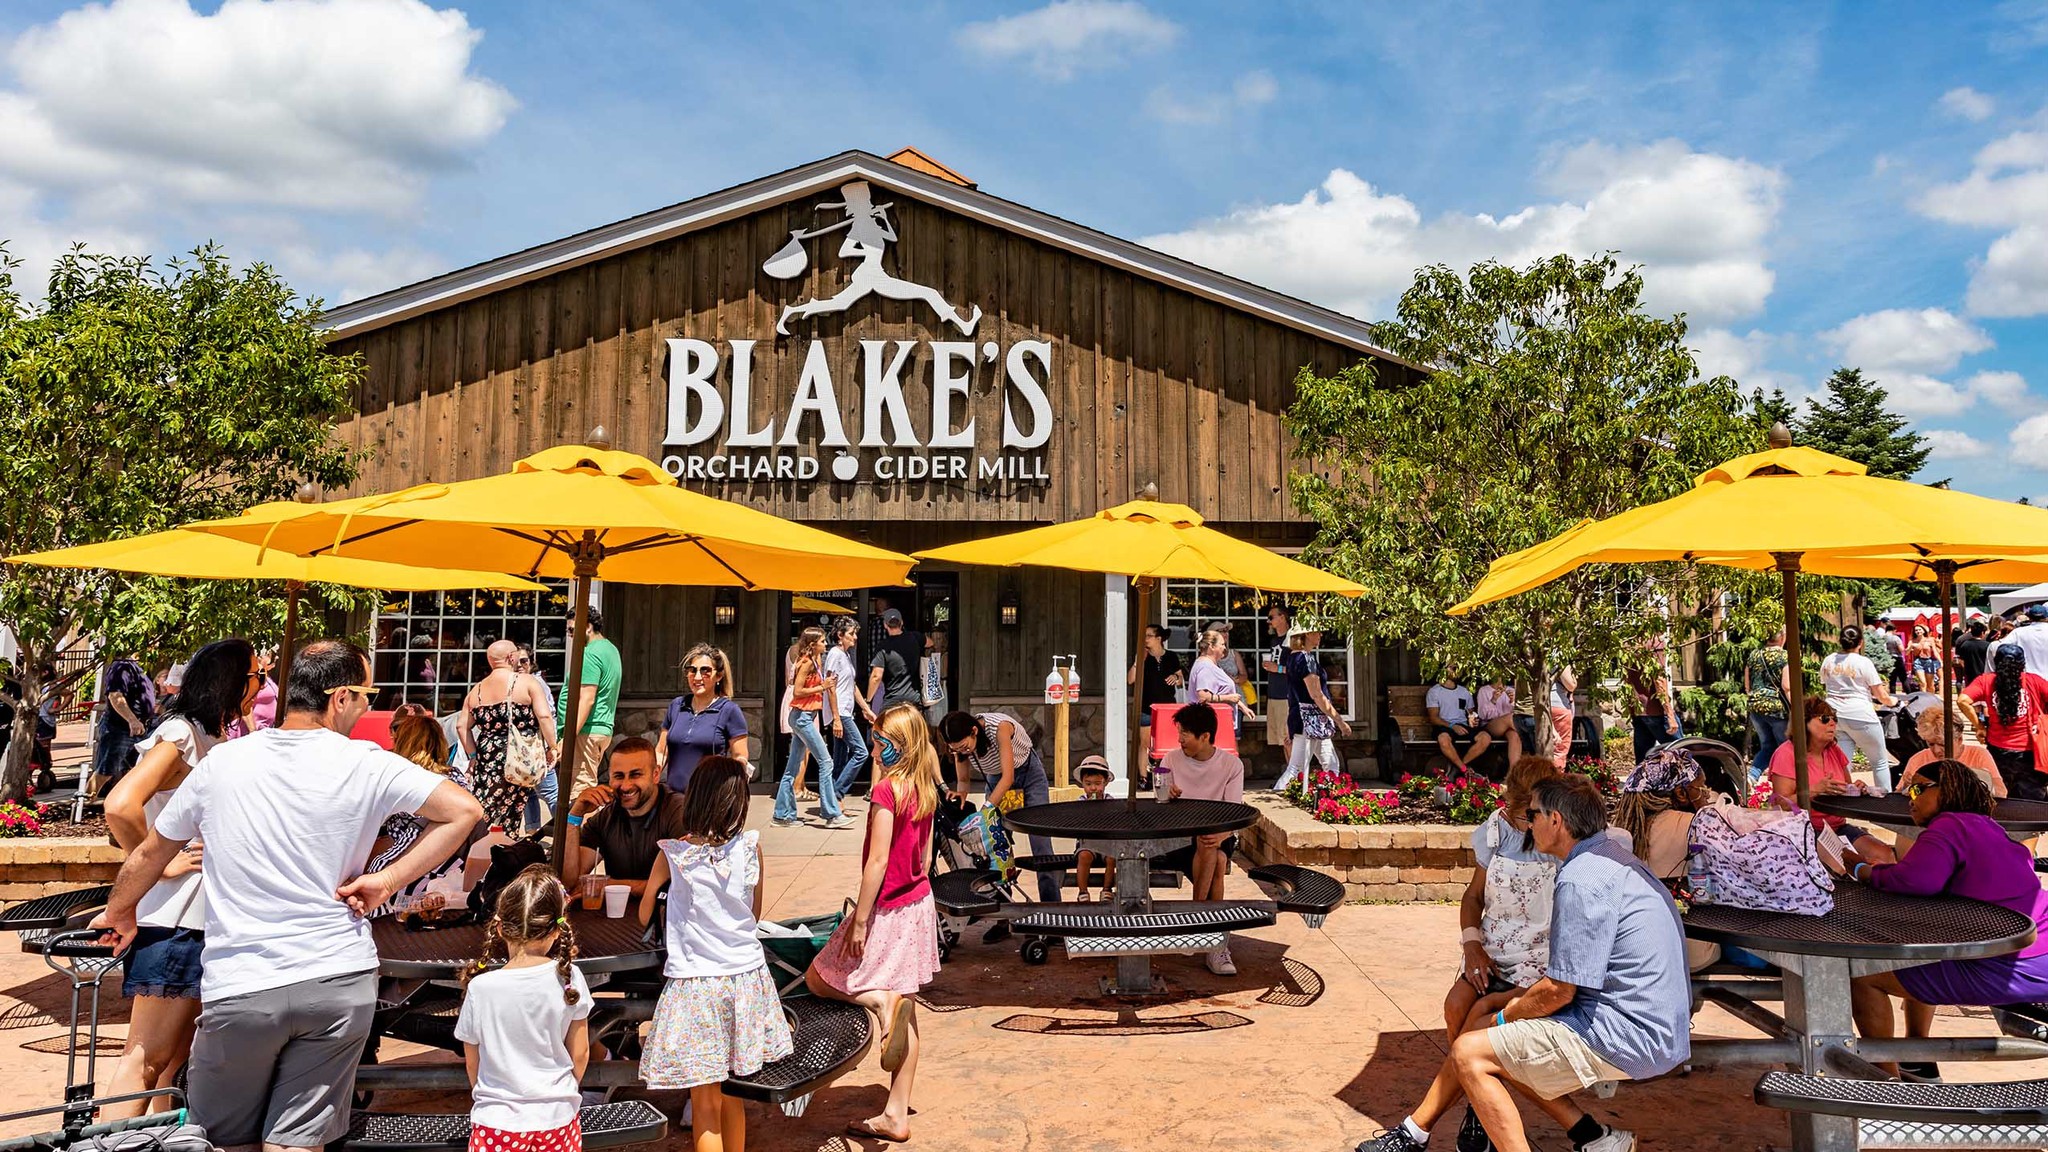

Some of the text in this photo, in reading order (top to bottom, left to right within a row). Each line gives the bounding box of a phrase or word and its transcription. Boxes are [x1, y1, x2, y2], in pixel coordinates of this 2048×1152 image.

[661, 338, 1053, 448] BLAKE'S
[661, 455, 1050, 480] ORCHARD CIDER MILL
[832, 590, 853, 598] ROUND
